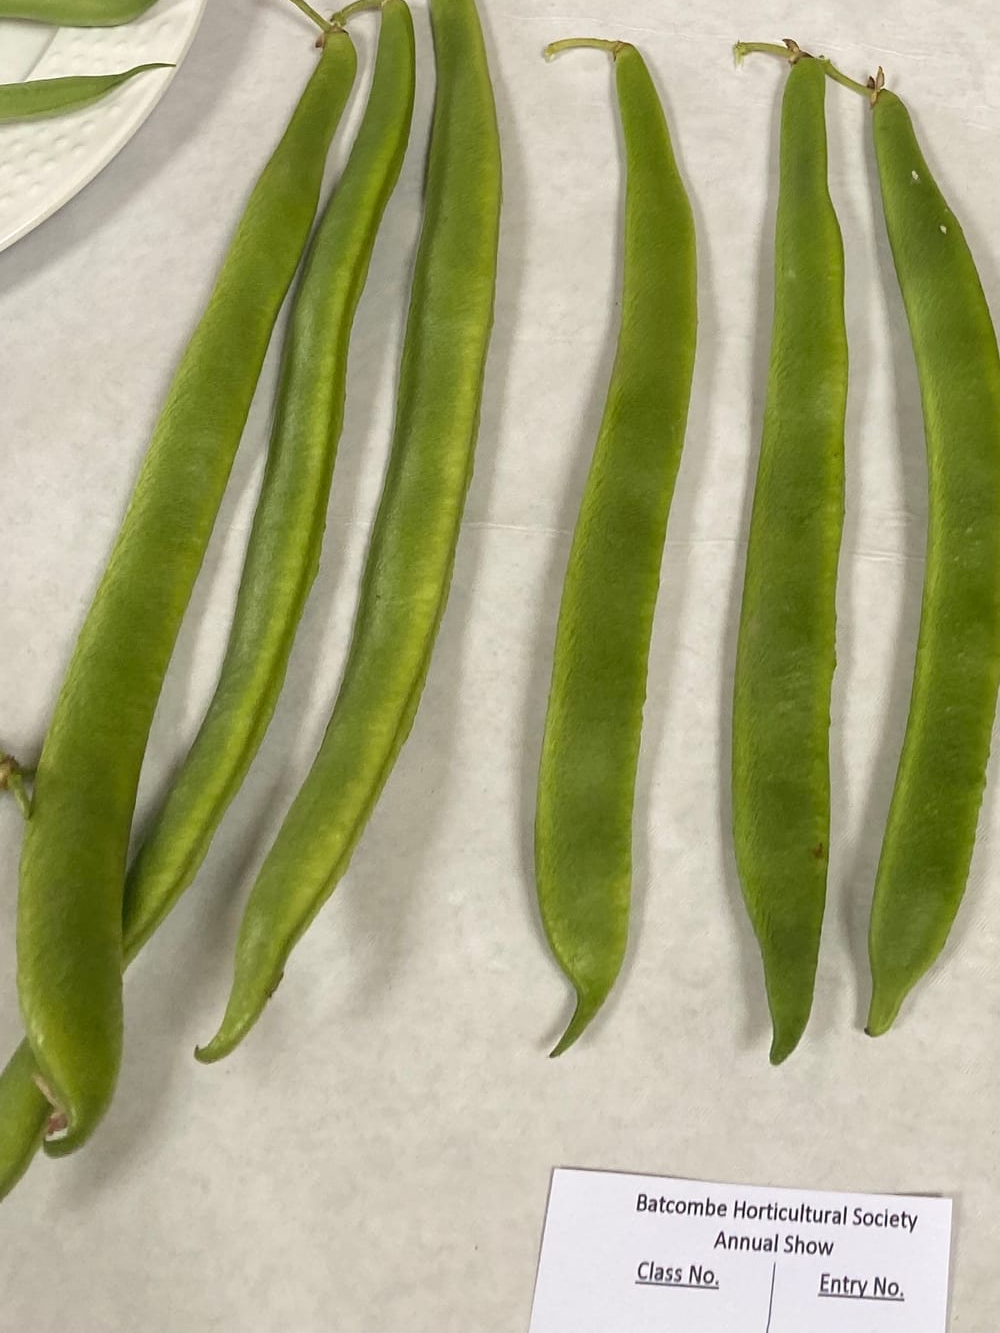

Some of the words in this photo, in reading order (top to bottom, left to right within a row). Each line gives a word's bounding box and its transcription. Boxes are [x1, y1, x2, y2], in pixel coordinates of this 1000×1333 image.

[636, 1193, 727, 1218] Batcombe
[733, 1200, 847, 1226] Horticultural
[852, 1207, 918, 1233] Society
[714, 1231, 778, 1253] Annual
[784, 1235, 834, 1256] Show
[636, 1261, 682, 1284] Class
[689, 1266, 720, 1286] No.
[819, 1274, 868, 1298] Entry
[873, 1277, 904, 1298] No.
